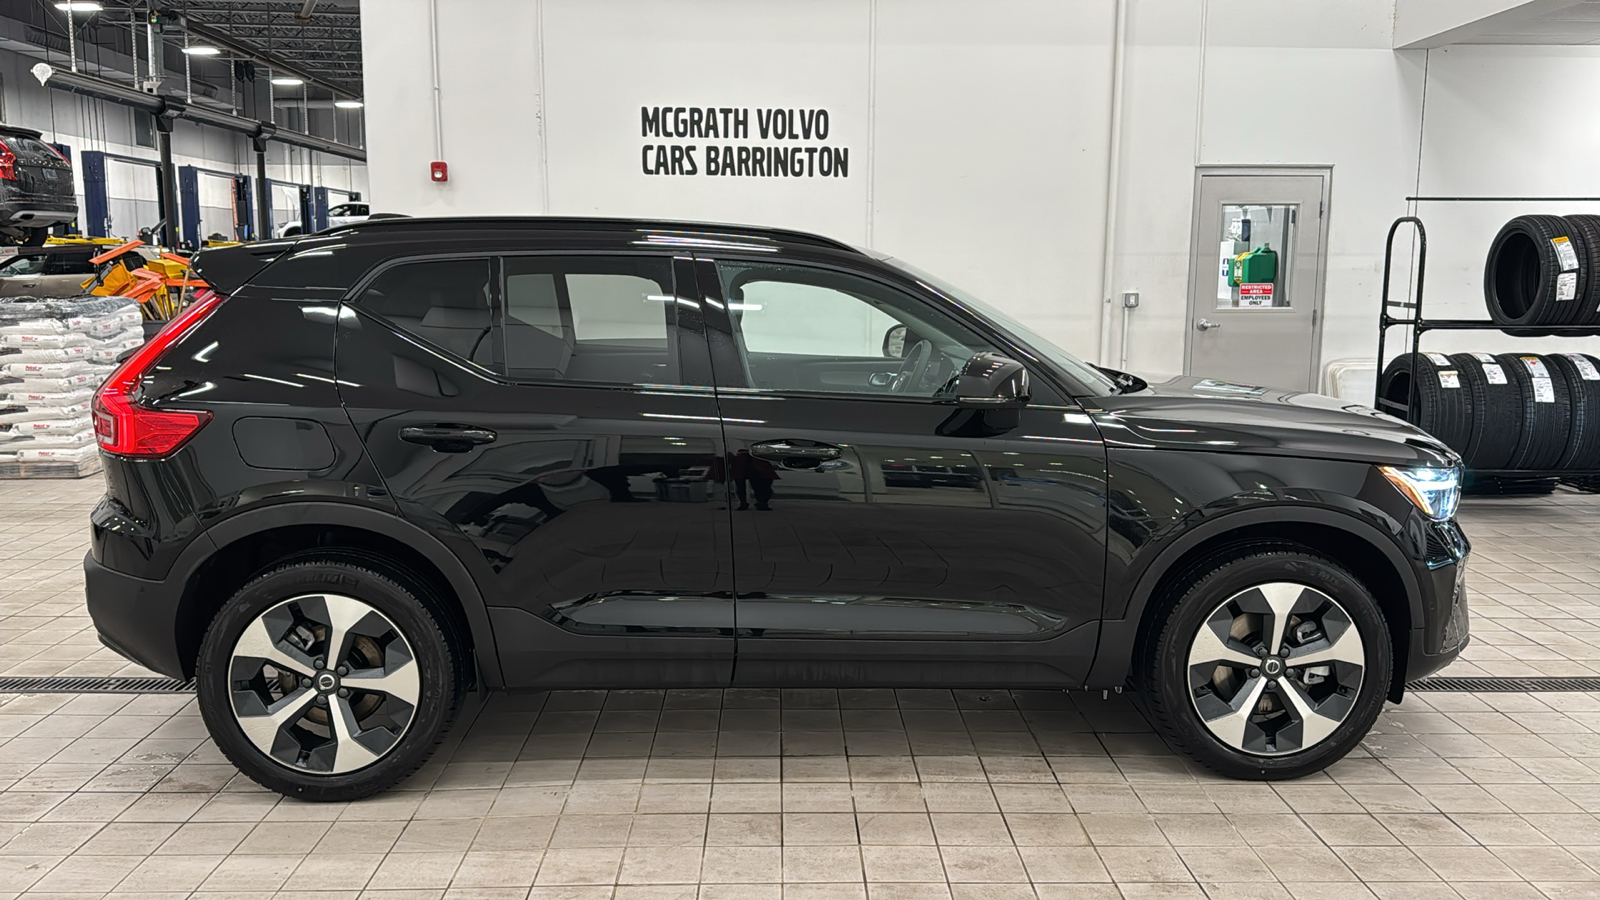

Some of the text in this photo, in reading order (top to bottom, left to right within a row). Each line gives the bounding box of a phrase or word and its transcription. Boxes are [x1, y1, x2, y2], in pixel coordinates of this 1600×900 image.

[641, 106, 829, 140] MCGRATH VOLVO
[642, 145, 849, 178] CARS BARRINGTON
